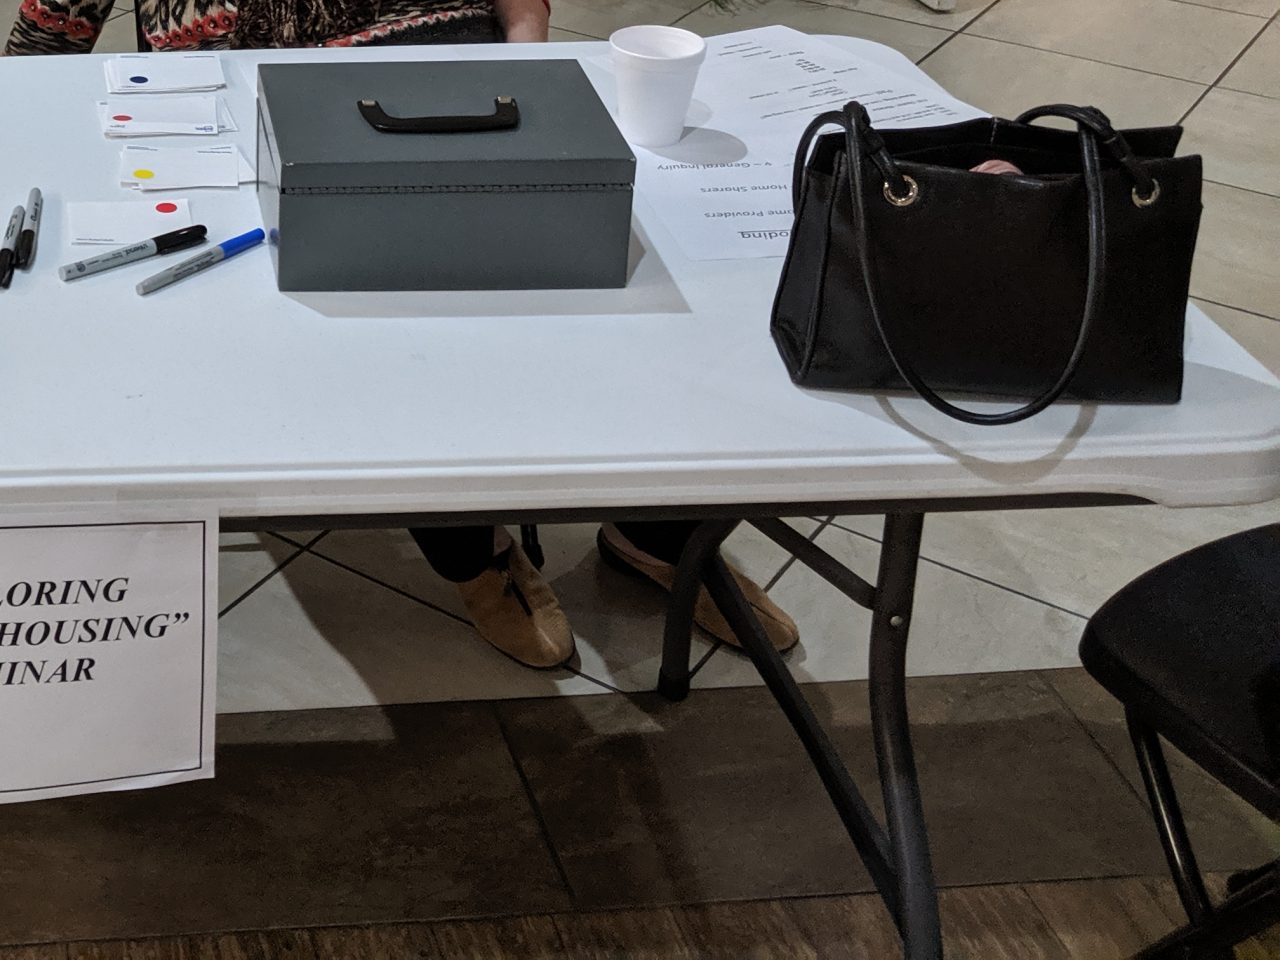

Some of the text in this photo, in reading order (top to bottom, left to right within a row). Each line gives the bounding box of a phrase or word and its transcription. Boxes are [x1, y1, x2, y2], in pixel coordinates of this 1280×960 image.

[656, 161, 700, 171] Inquiry
[703, 161, 751, 170] General
[699, 183, 788, 193] Home Sharers
[703, 210, 764, 218] Providers
